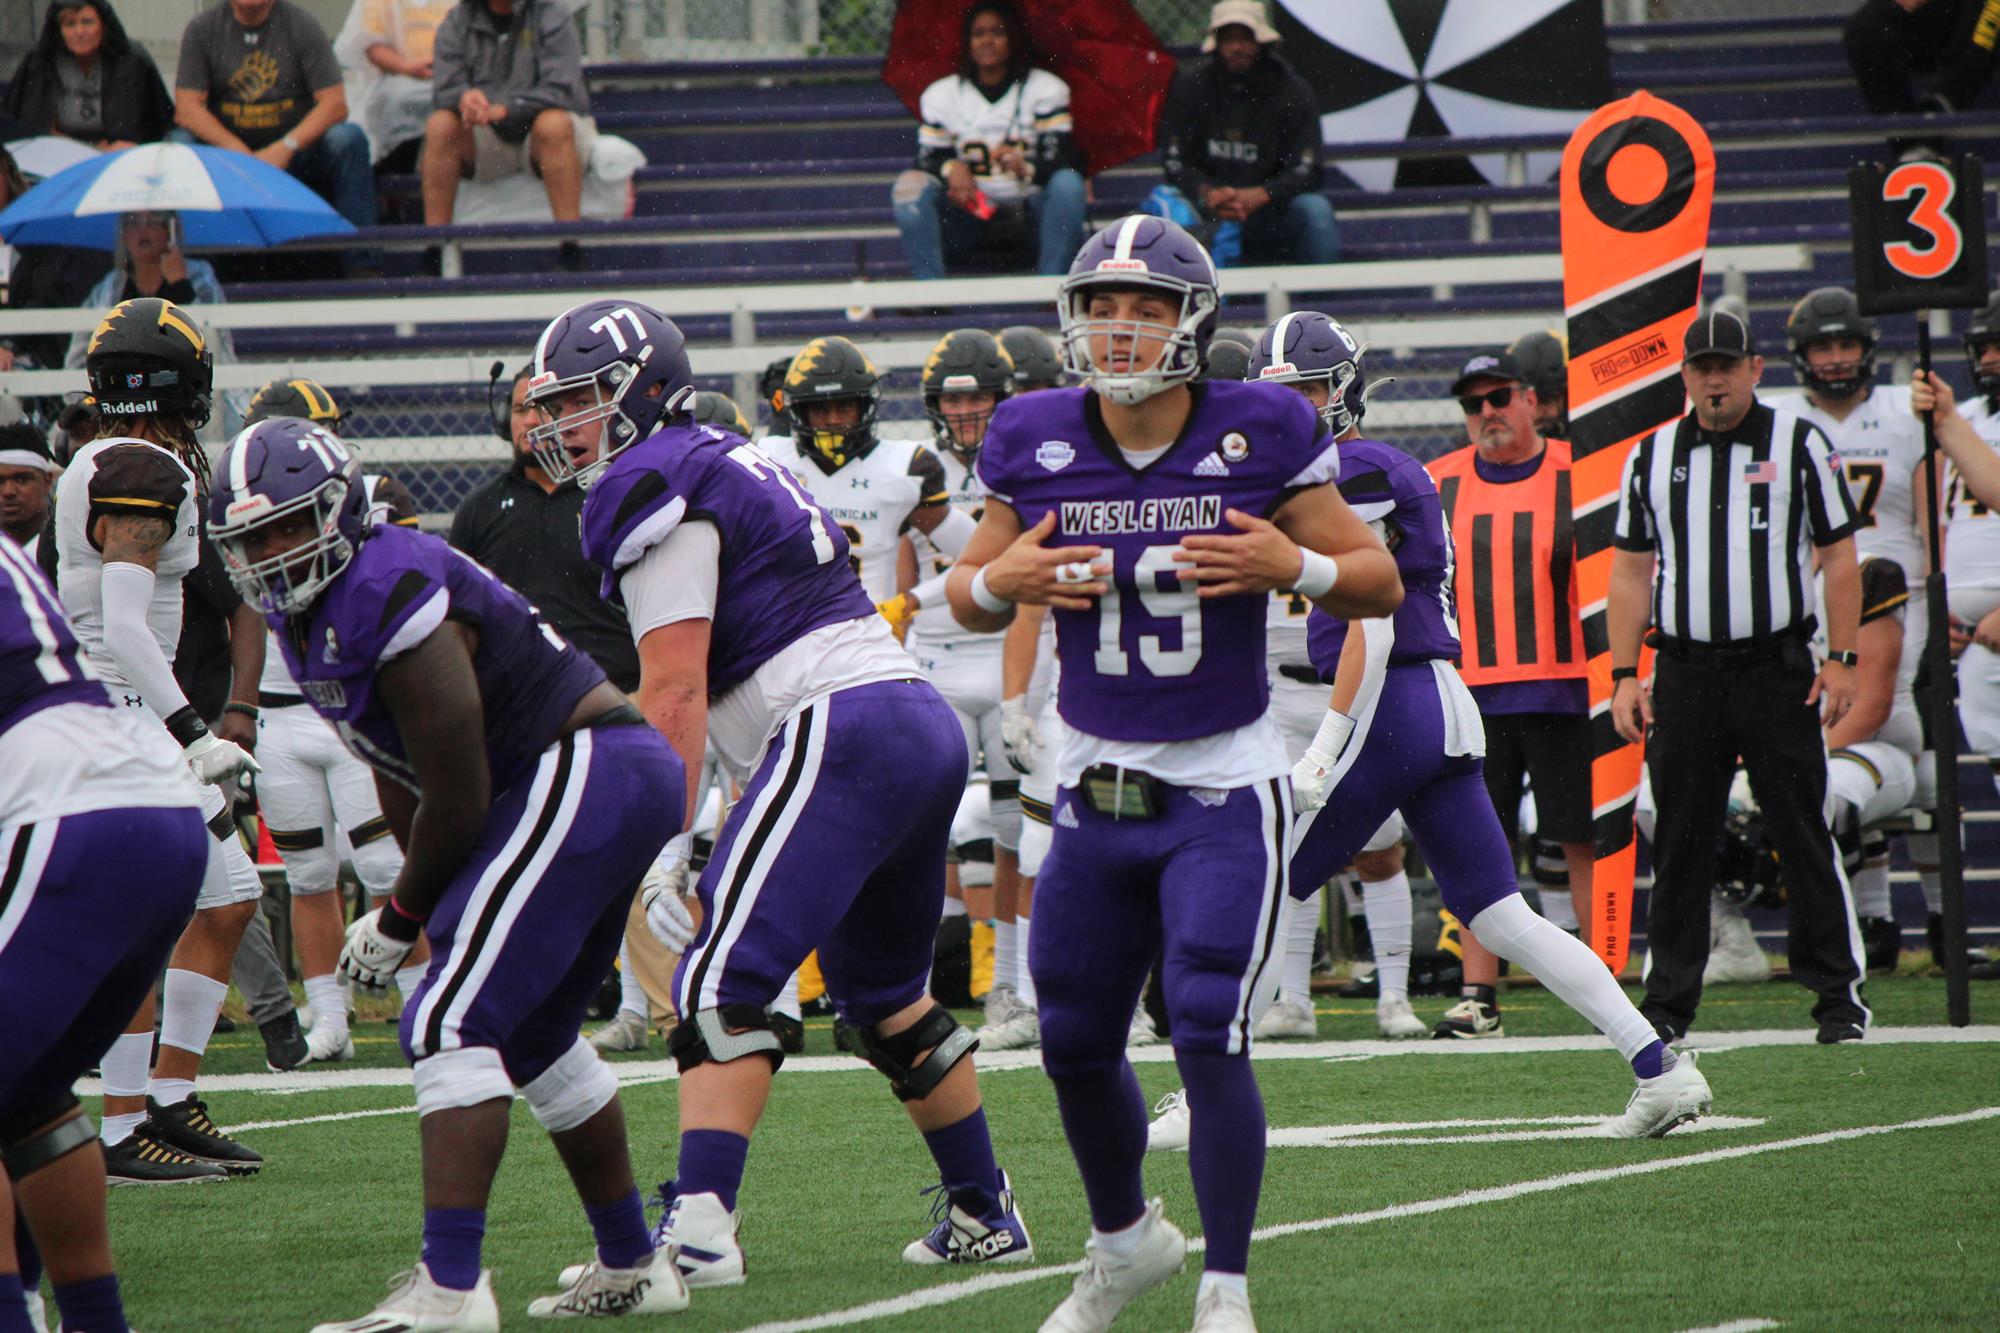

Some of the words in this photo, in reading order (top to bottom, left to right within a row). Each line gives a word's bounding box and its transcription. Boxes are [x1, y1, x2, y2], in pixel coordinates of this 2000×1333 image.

[1882, 161, 1963, 279] 3
[588, 307, 648, 354] 77
[1328, 322, 1357, 353] 6
[1263, 365, 1292, 376] Riddell
[1591, 358, 1618, 382] PRO
[1630, 335, 1668, 365] DOWN
[101, 400, 158, 414] Riddell
[1672, 466, 1688, 483] S
[828, 507, 879, 521] MINICAN
[1060, 494, 1222, 536] WESLEYAN
[1750, 507, 1769, 530] L
[1089, 544, 1203, 678] 19
[1606, 891, 1617, 922] DOWN
[1606, 935, 1617, 957] PRO
